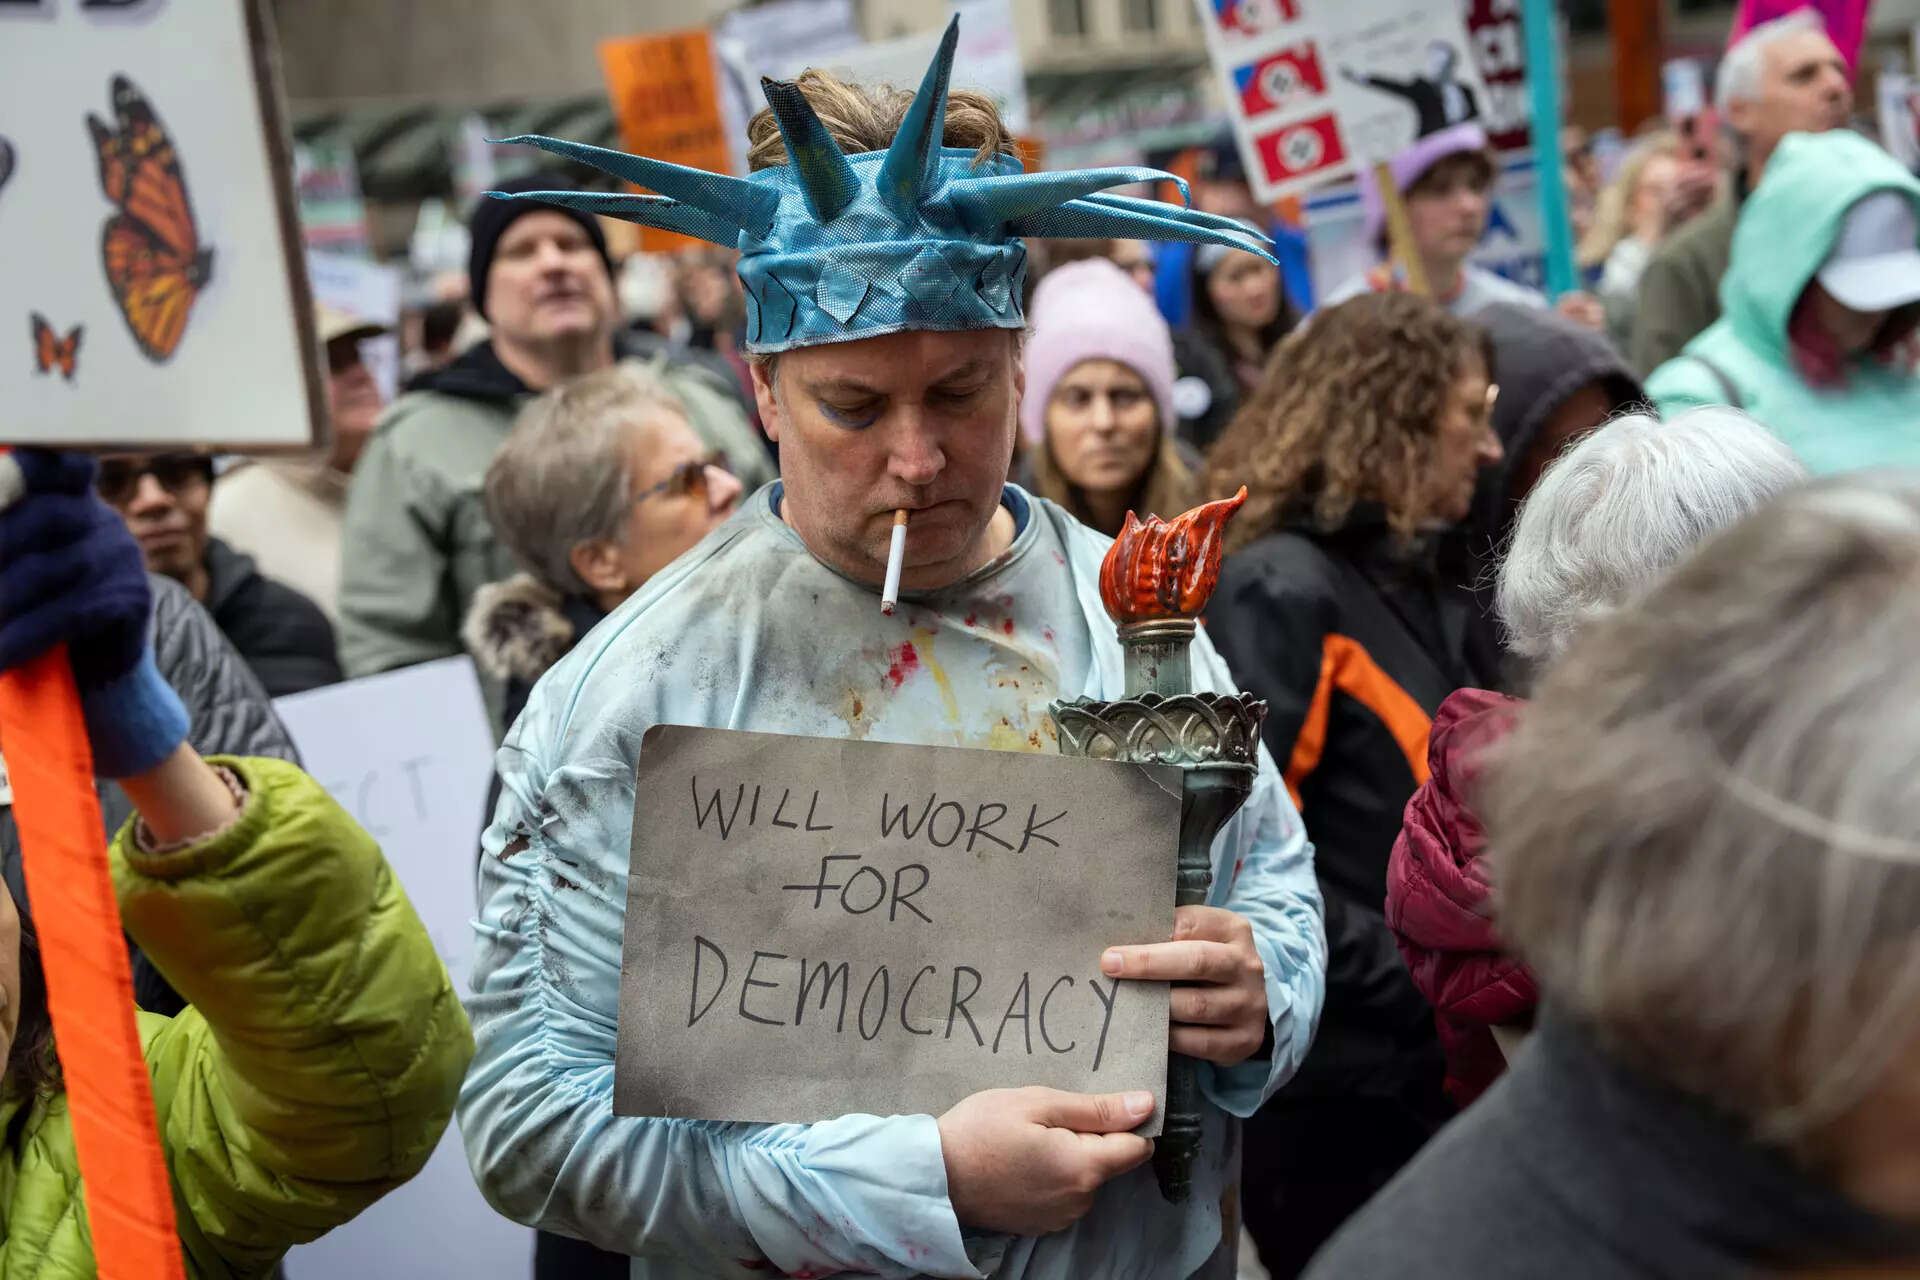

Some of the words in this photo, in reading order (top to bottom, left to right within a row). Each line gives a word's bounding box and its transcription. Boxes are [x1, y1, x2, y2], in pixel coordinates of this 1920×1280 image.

[691, 775, 834, 841] WILL
[880, 792, 1068, 855] WORK
[782, 854, 933, 924] FOR
[687, 935, 1122, 1073] DEMOCRACY
